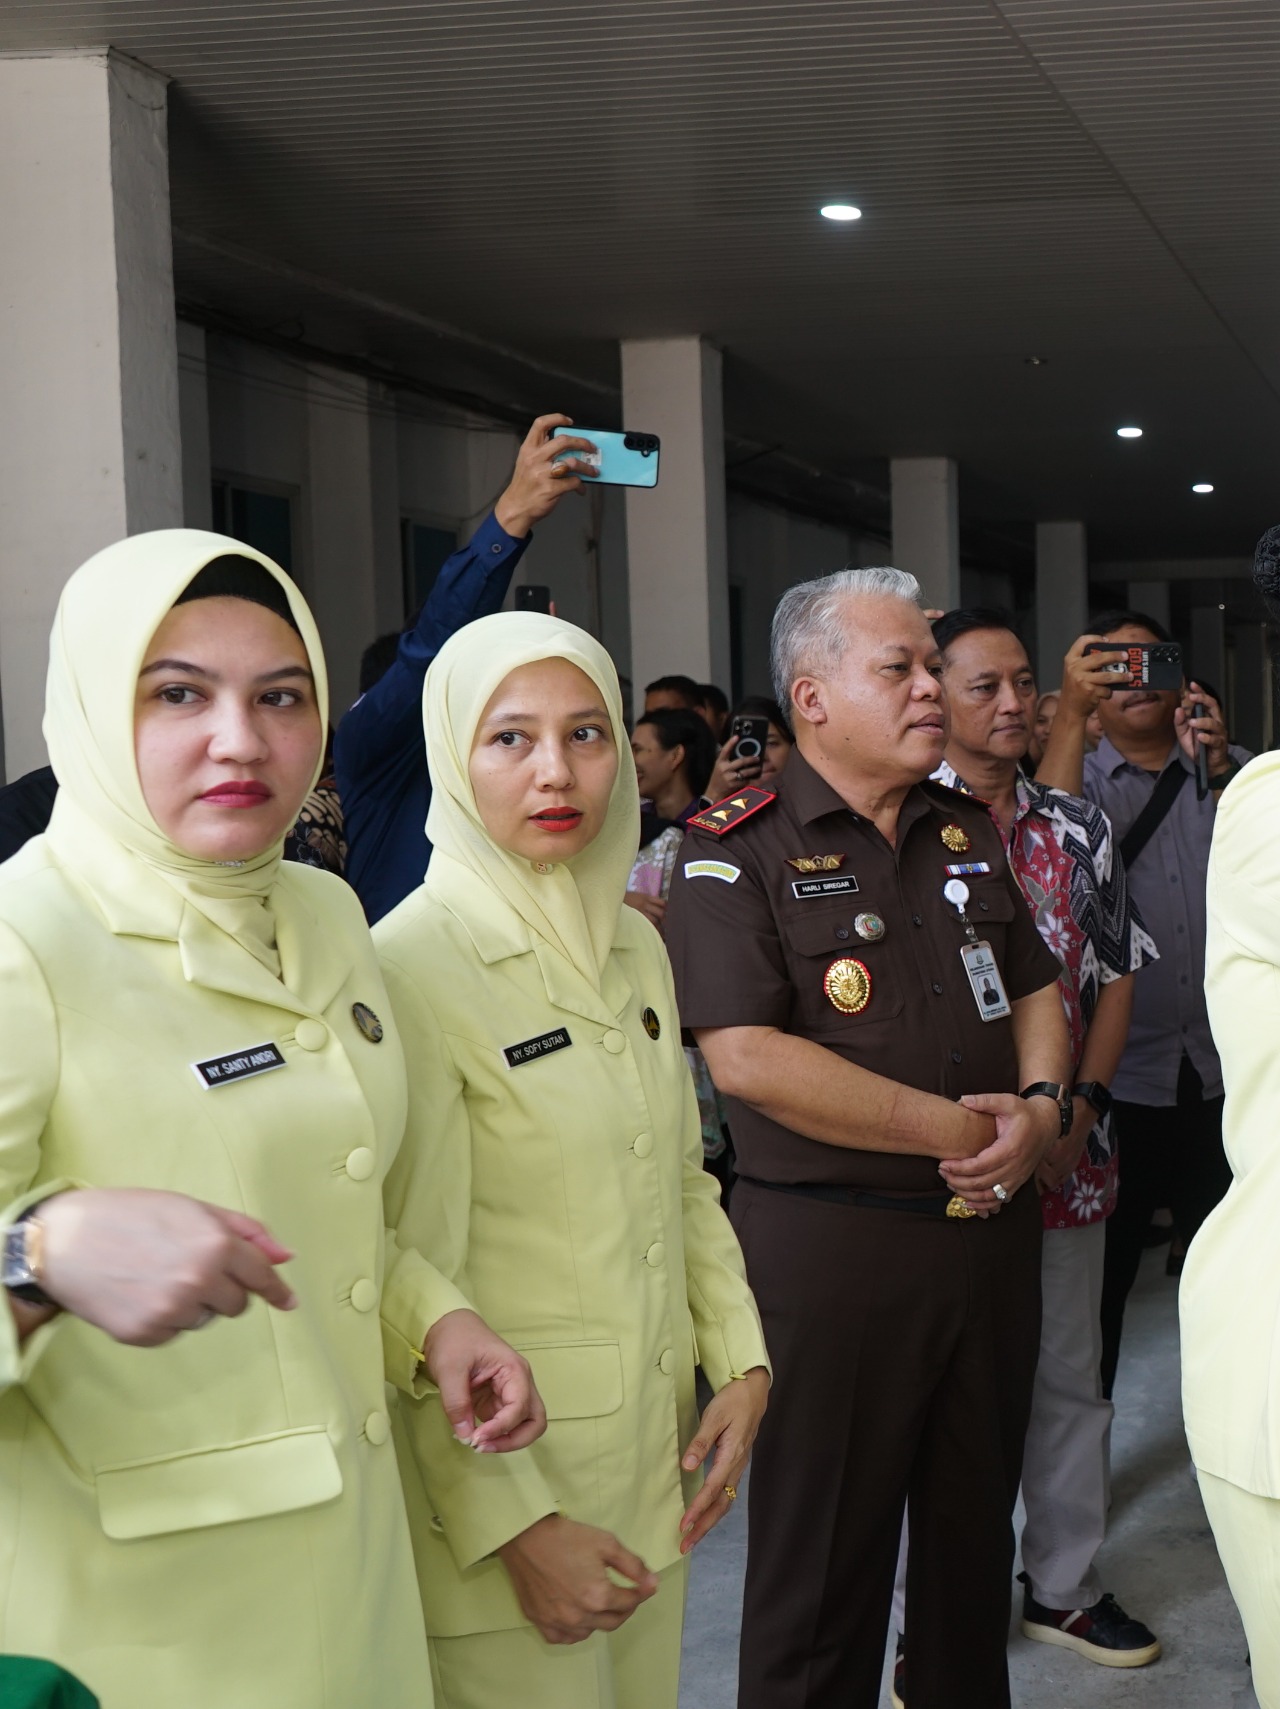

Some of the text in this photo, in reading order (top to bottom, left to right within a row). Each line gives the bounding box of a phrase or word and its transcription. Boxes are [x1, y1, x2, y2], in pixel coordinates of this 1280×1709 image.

[802, 881, 850, 892] HARLI SIREGAR
[512, 1034, 565, 1060] NY. SOFY SUTAN
[221, 1057, 252, 1075] SANTY
[250, 1050, 277, 1067] ANDRI
